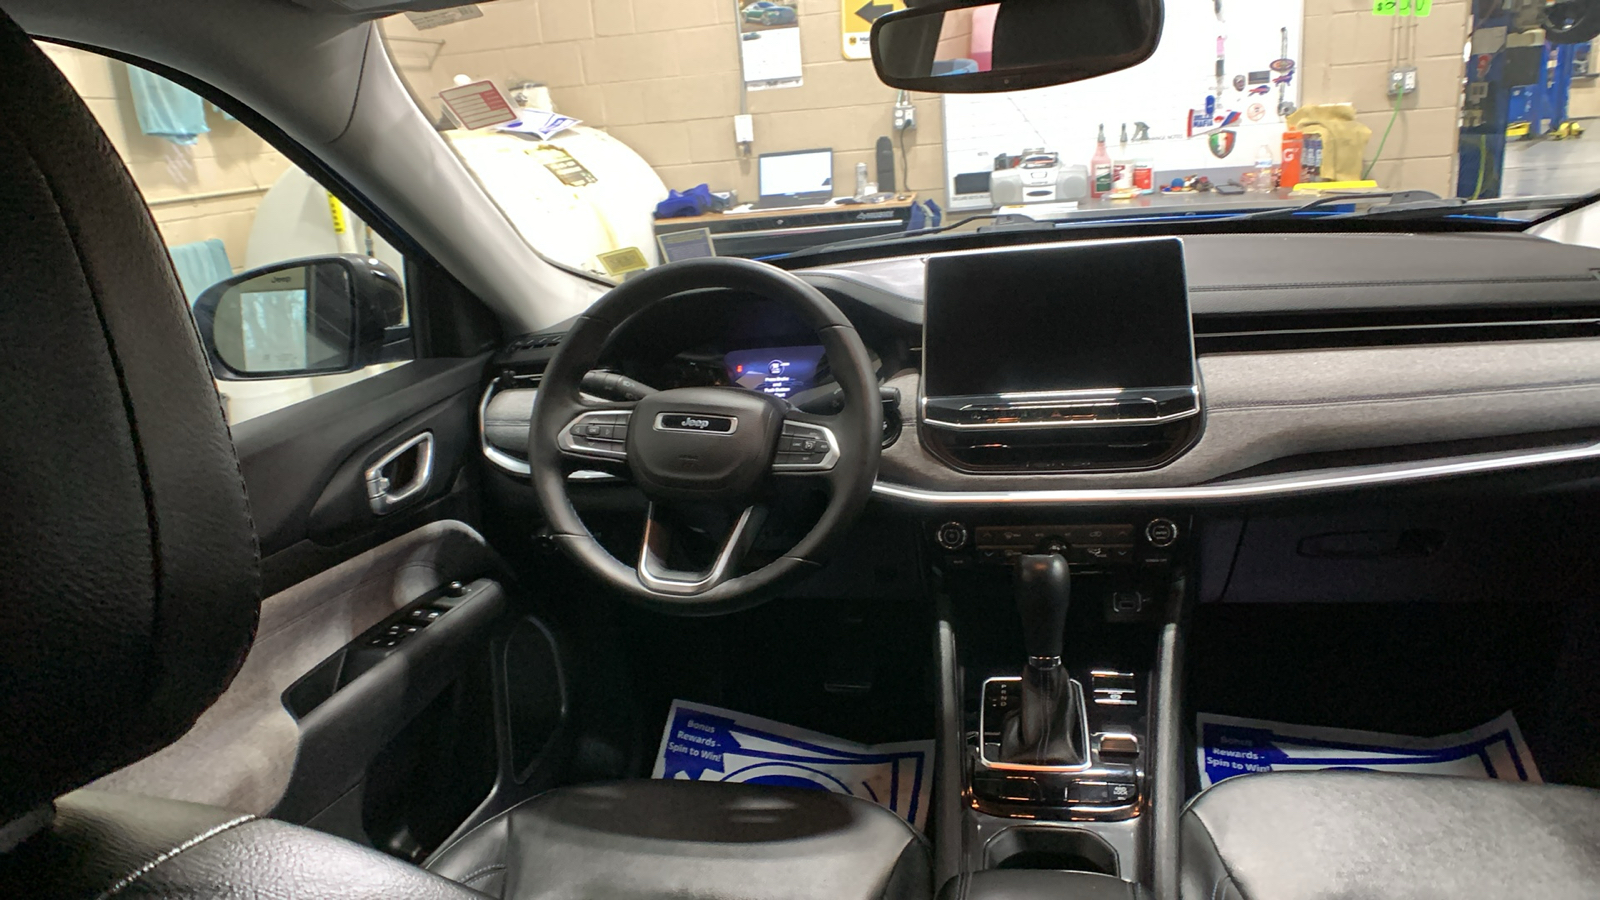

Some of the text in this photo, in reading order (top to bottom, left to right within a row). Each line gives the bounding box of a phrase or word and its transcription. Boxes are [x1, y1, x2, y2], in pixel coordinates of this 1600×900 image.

[1193, 119, 1213, 128] MAFIA
[271, 276, 292, 284] Jeep
[681, 417, 709, 429] Jeep
[687, 720, 715, 733] Bonus
[677, 730, 716, 747] Rewards
[668, 741, 722, 762] Spin to Win!
[1212, 747, 1259, 760] Rewards
[1206, 756, 1230, 768] Spin
[1231, 761, 1244, 770] to
